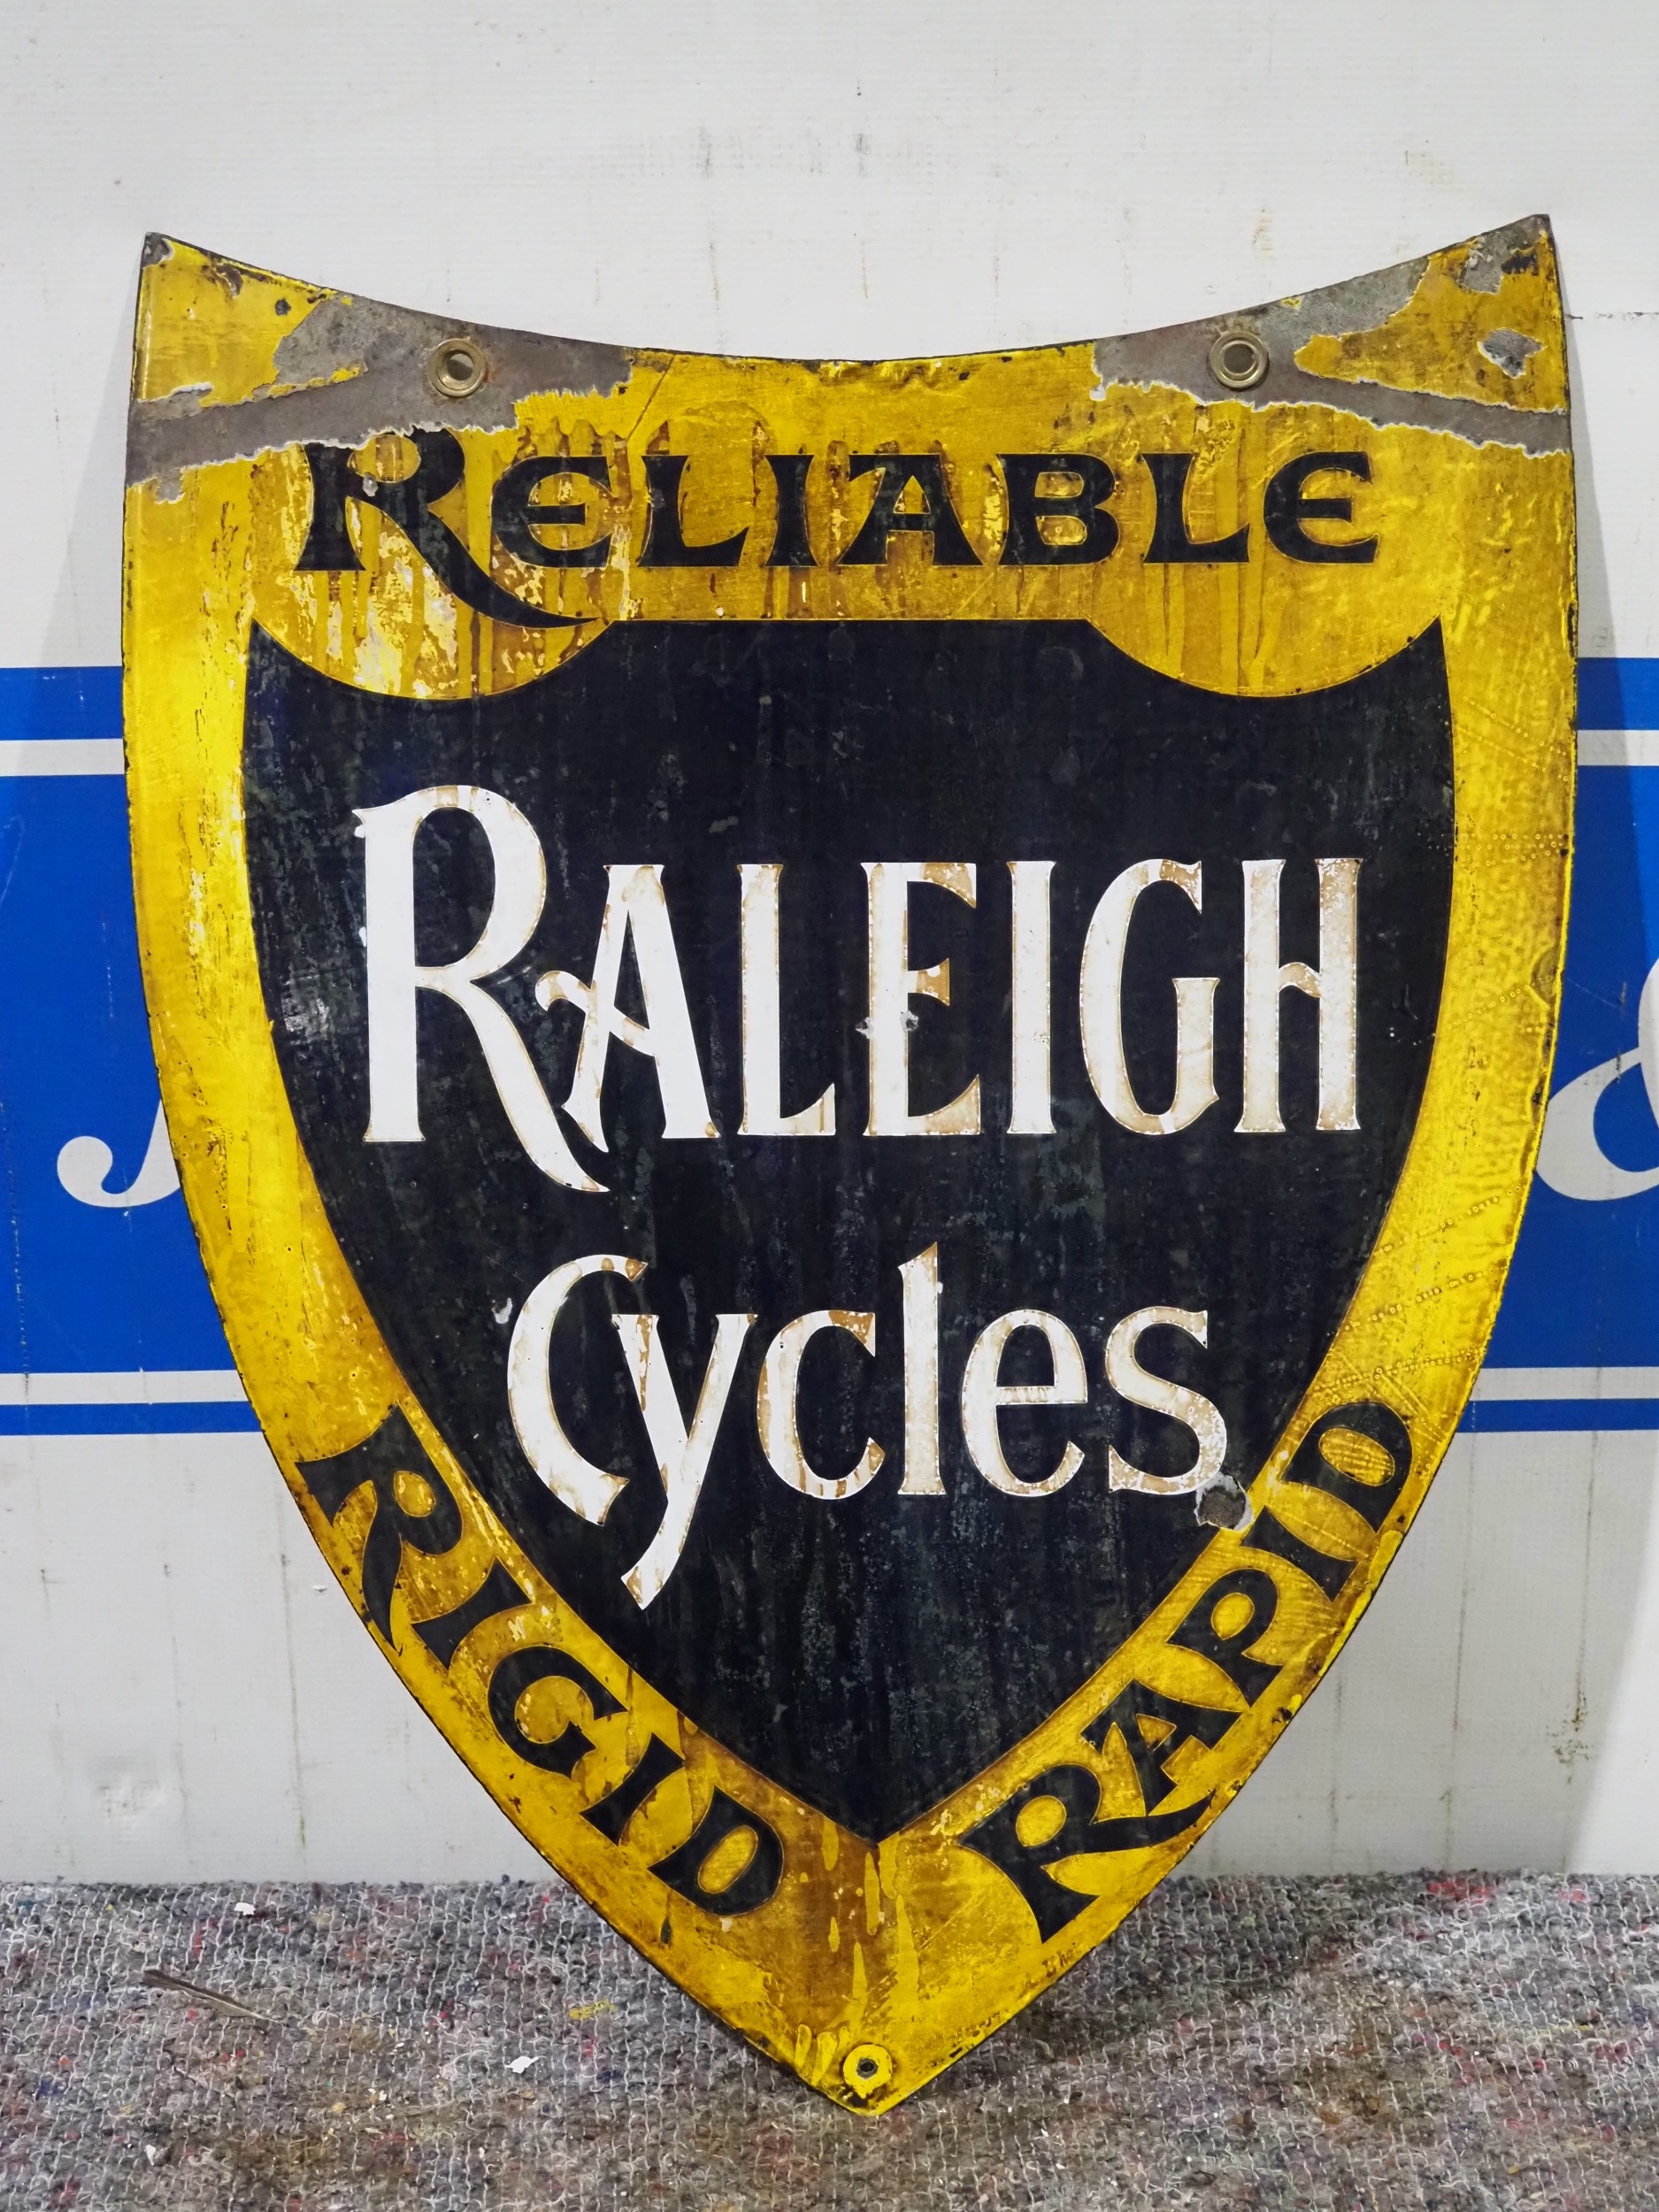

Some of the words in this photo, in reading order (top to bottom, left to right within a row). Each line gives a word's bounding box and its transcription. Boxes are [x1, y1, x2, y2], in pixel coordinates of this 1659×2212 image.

[295, 429, 1379, 628] RELIABLE
[351, 785, 1363, 1193] RALEIGH
[507, 1242, 1227, 1610] Cycles
[296, 1404, 784, 1916] RIGID
[957, 1401, 1413, 1944] RAPID
